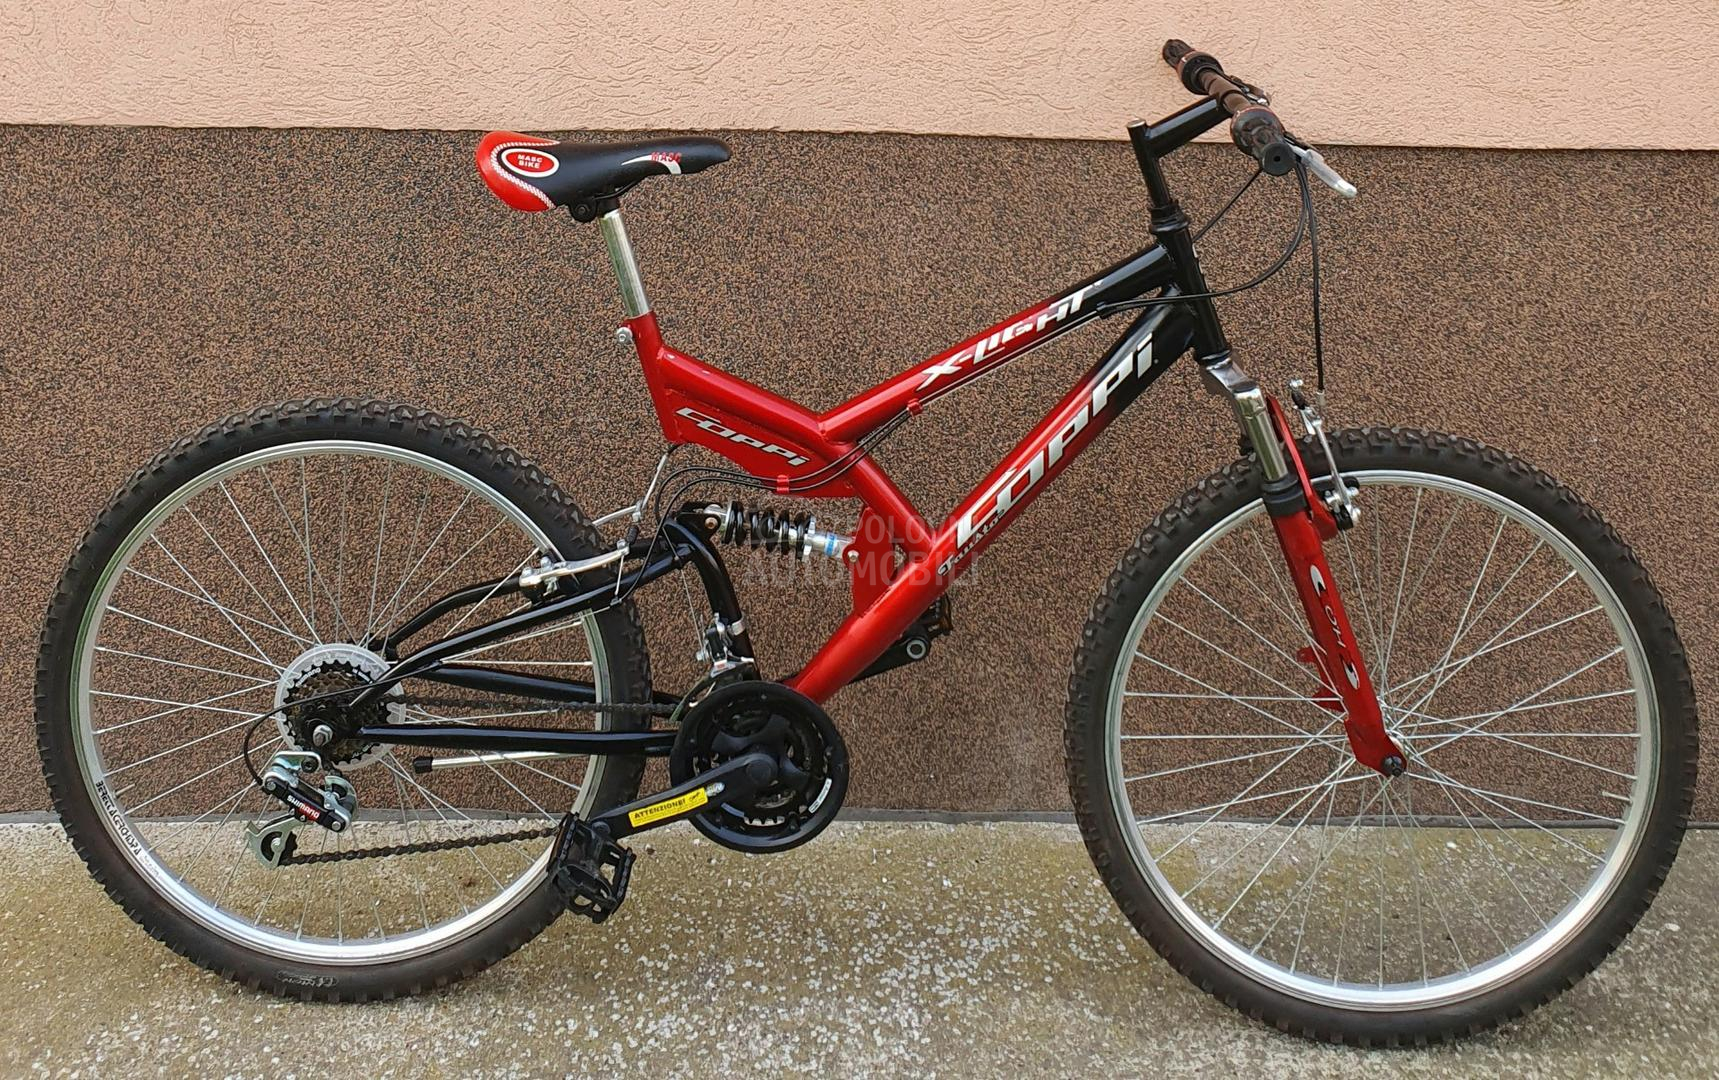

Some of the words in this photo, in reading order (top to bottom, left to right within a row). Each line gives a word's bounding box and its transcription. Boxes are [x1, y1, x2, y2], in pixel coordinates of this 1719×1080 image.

[517, 154, 543, 163] MASC
[518, 160, 540, 169] BIKE
[286, 794, 321, 819] SHIMANO
[633, 797, 686, 820] ATTENZIONE!
